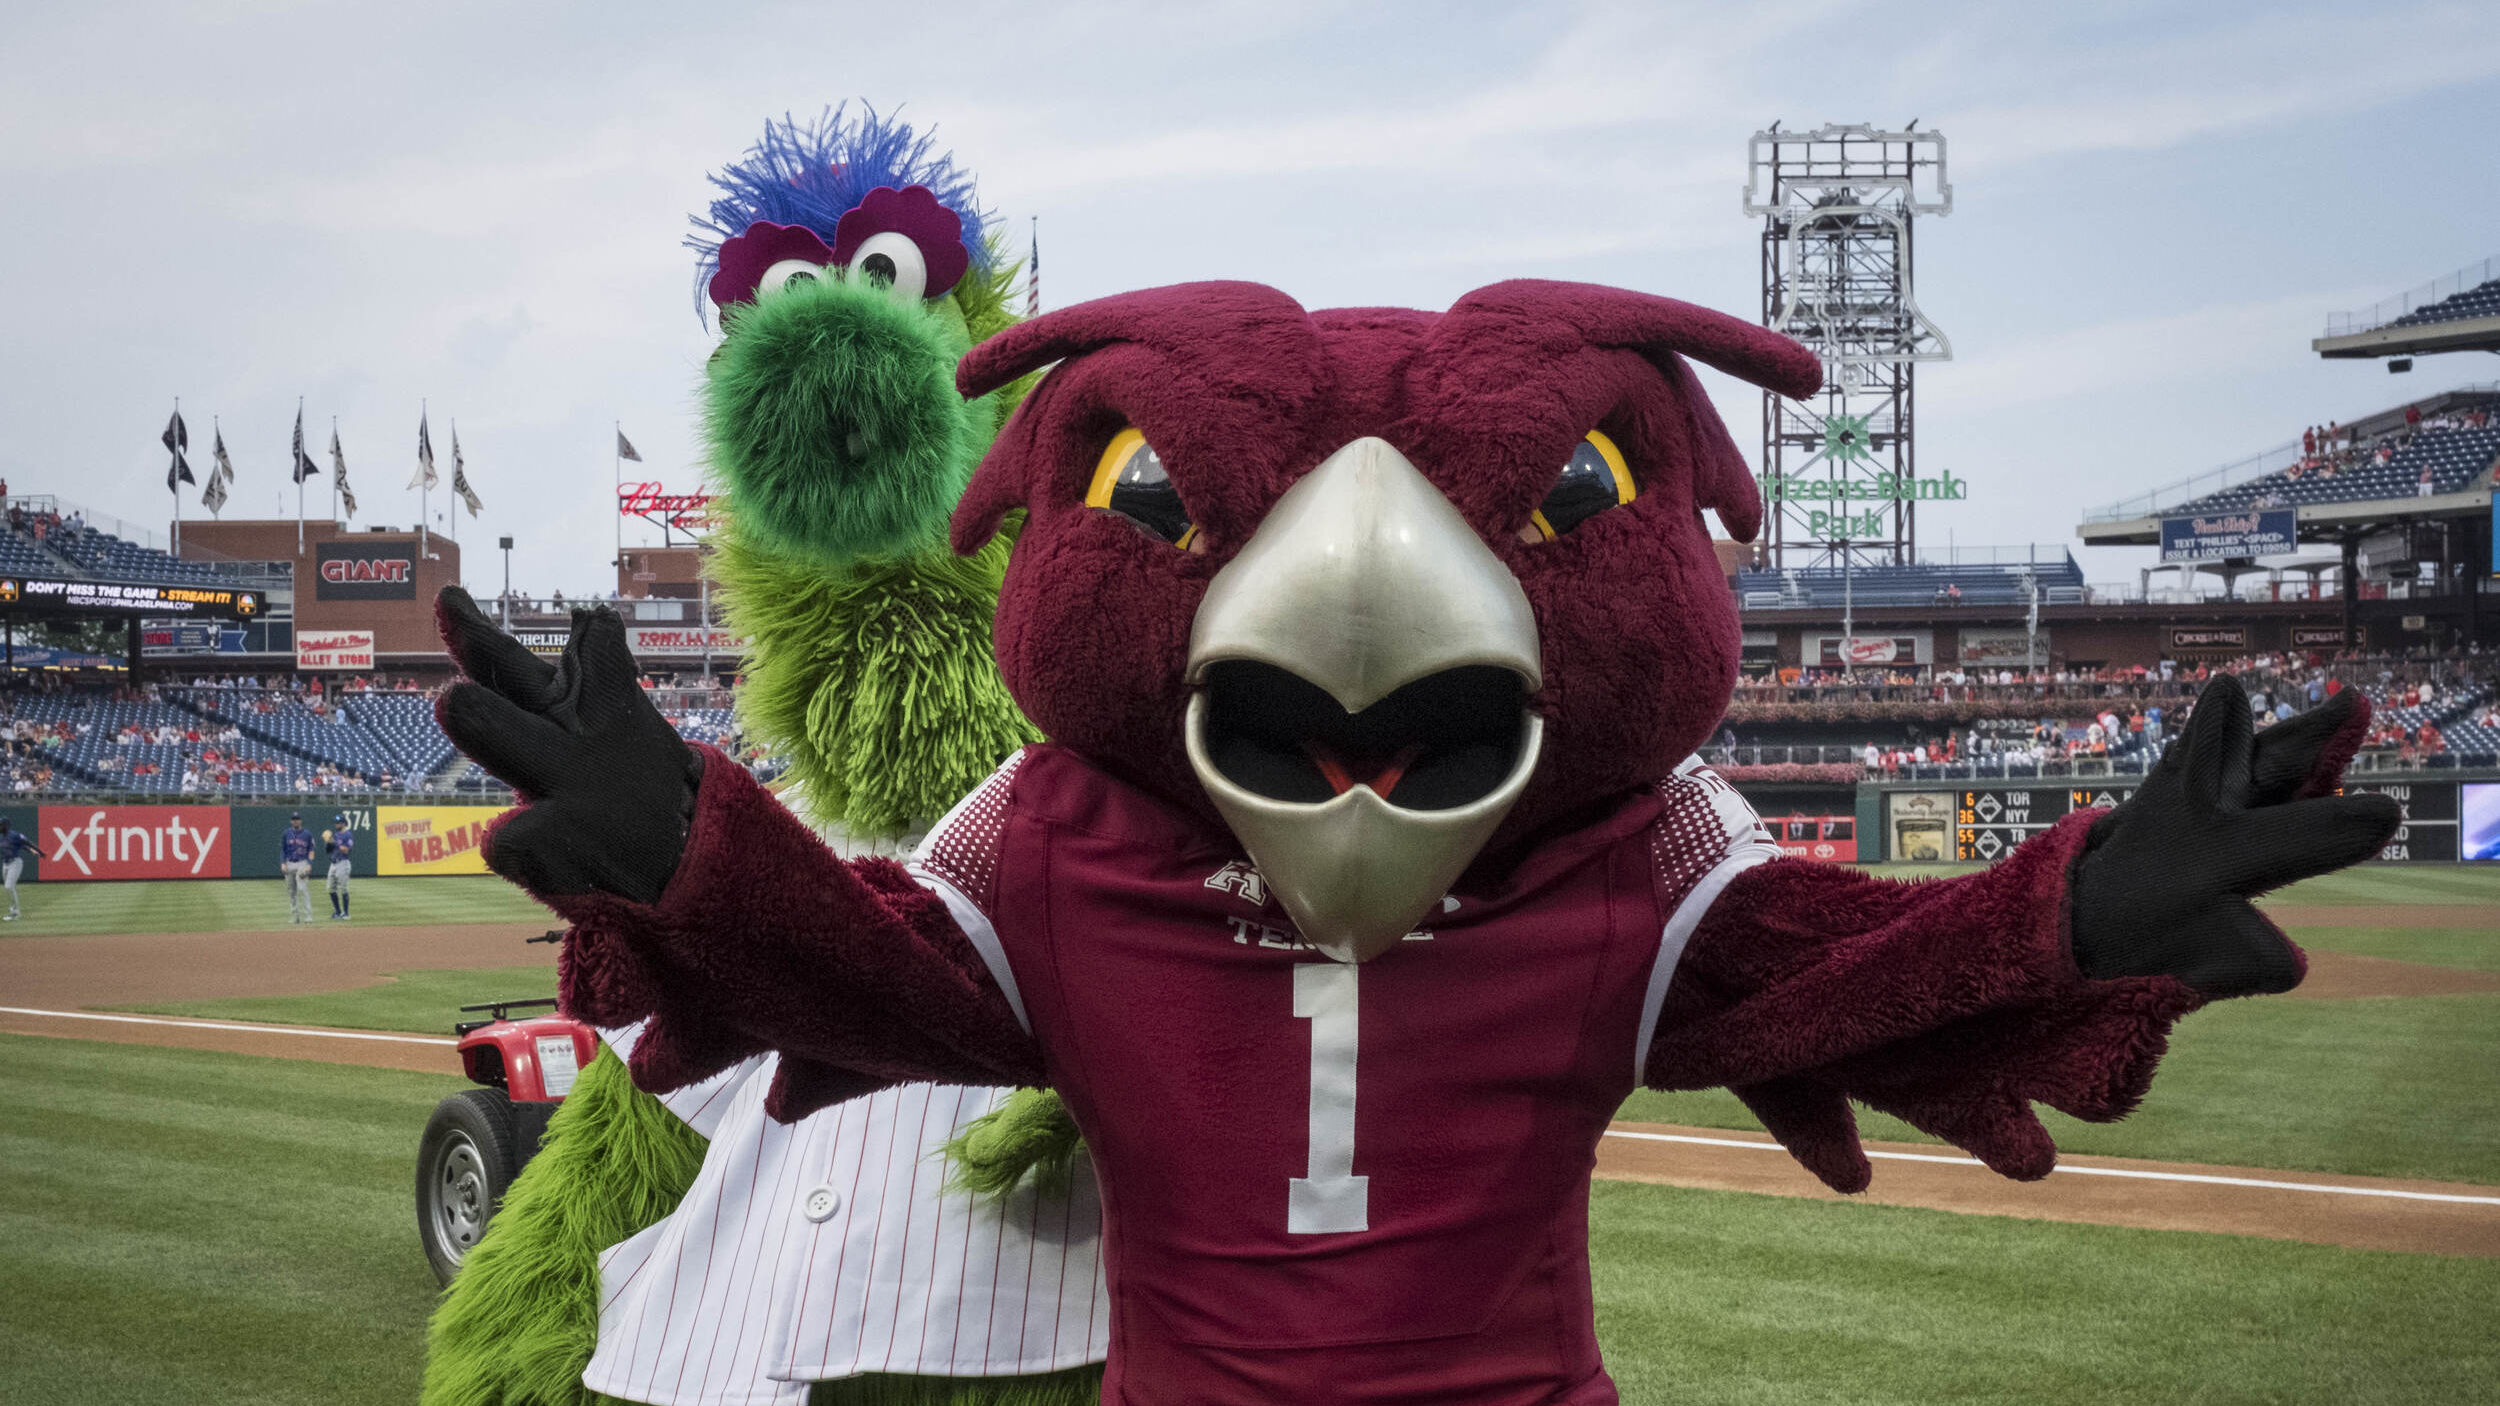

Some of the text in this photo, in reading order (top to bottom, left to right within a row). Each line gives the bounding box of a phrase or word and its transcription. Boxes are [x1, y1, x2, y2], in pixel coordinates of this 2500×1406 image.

[1756, 469, 1963, 503] itizens Bank
[1810, 508, 1882, 538] Park
[2165, 550, 2190, 560] ISSUE
[2201, 546, 2246, 557] LOCATION
[2248, 544, 2261, 554] TO
[2174, 539, 2195, 549] TEXT
[322, 559, 411, 583] GIANT
[26, 581, 65, 595] DON'T
[66, 583, 96, 597] MISS
[98, 586, 122, 598] THE
[123, 587, 159, 600] GAME
[167, 589, 215, 603] STREAM
[66, 595, 194, 611] NBCSPORTSPHILADELPHIA.COM
[300, 654, 371, 665] ALLEY STORE
[1966, 792, 2030, 806] 6 TOR
[342, 810, 371, 831] 374
[1959, 809, 2030, 824] 36 NYY
[384, 819, 433, 838] WHO BUT
[52, 811, 219, 875] xfinity
[2382, 845, 2410, 860] SEA
[1287, 963, 1369, 1234] 1
